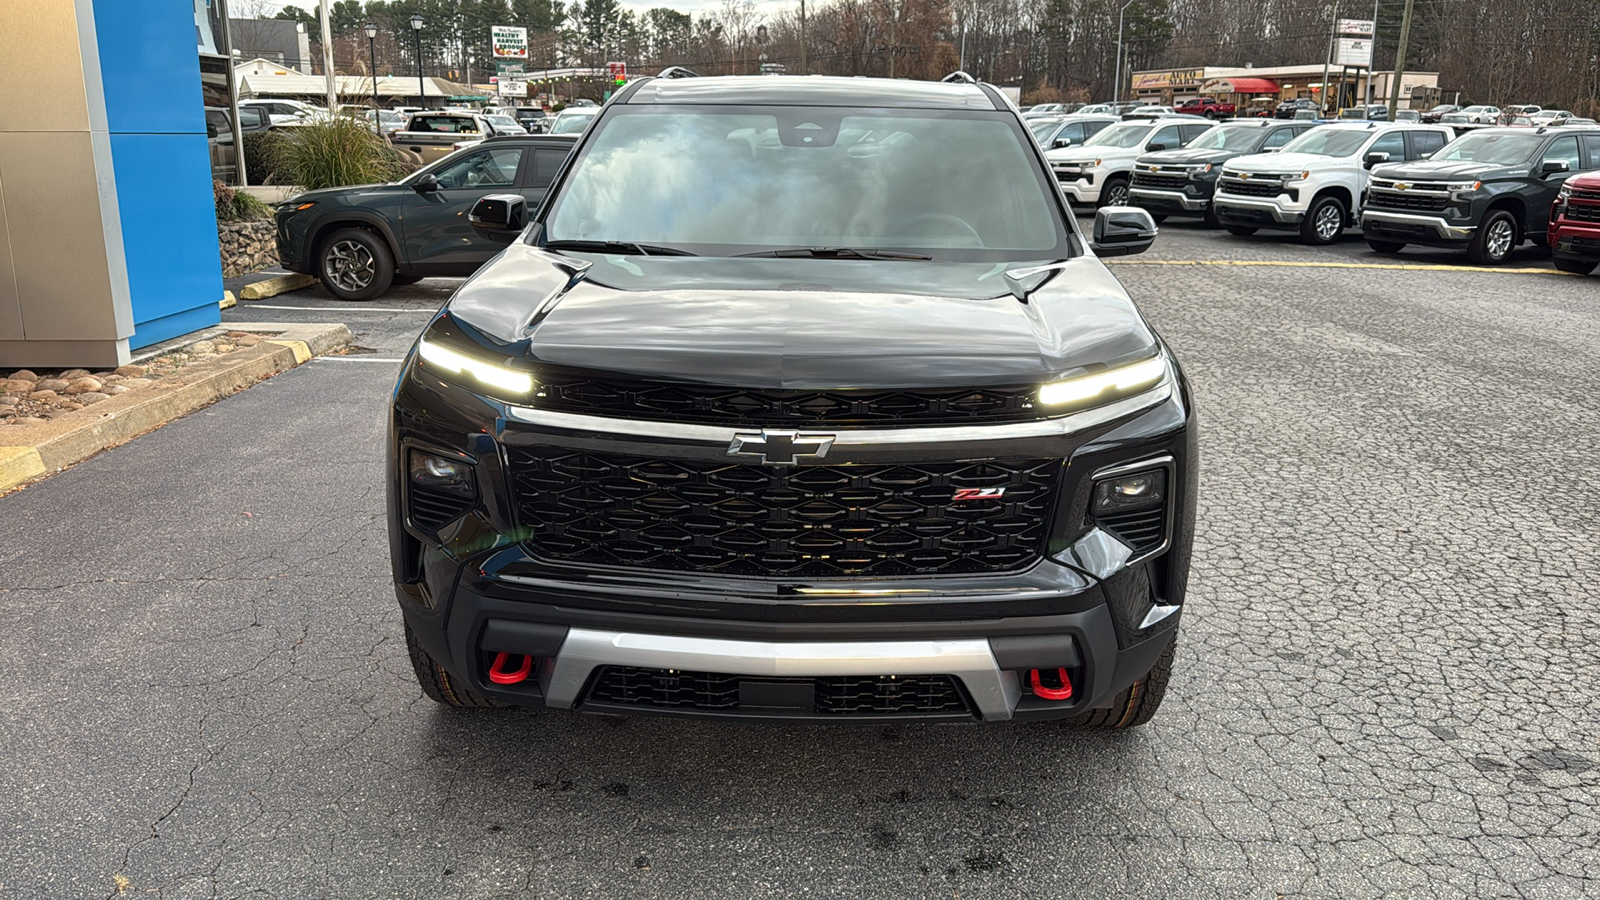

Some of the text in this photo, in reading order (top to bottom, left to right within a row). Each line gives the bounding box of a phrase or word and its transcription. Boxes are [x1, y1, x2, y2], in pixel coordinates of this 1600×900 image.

[1170, 70, 1197, 79] AUTO
[1168, 78, 1195, 86] MART
[952, 487, 1006, 500] Z71
